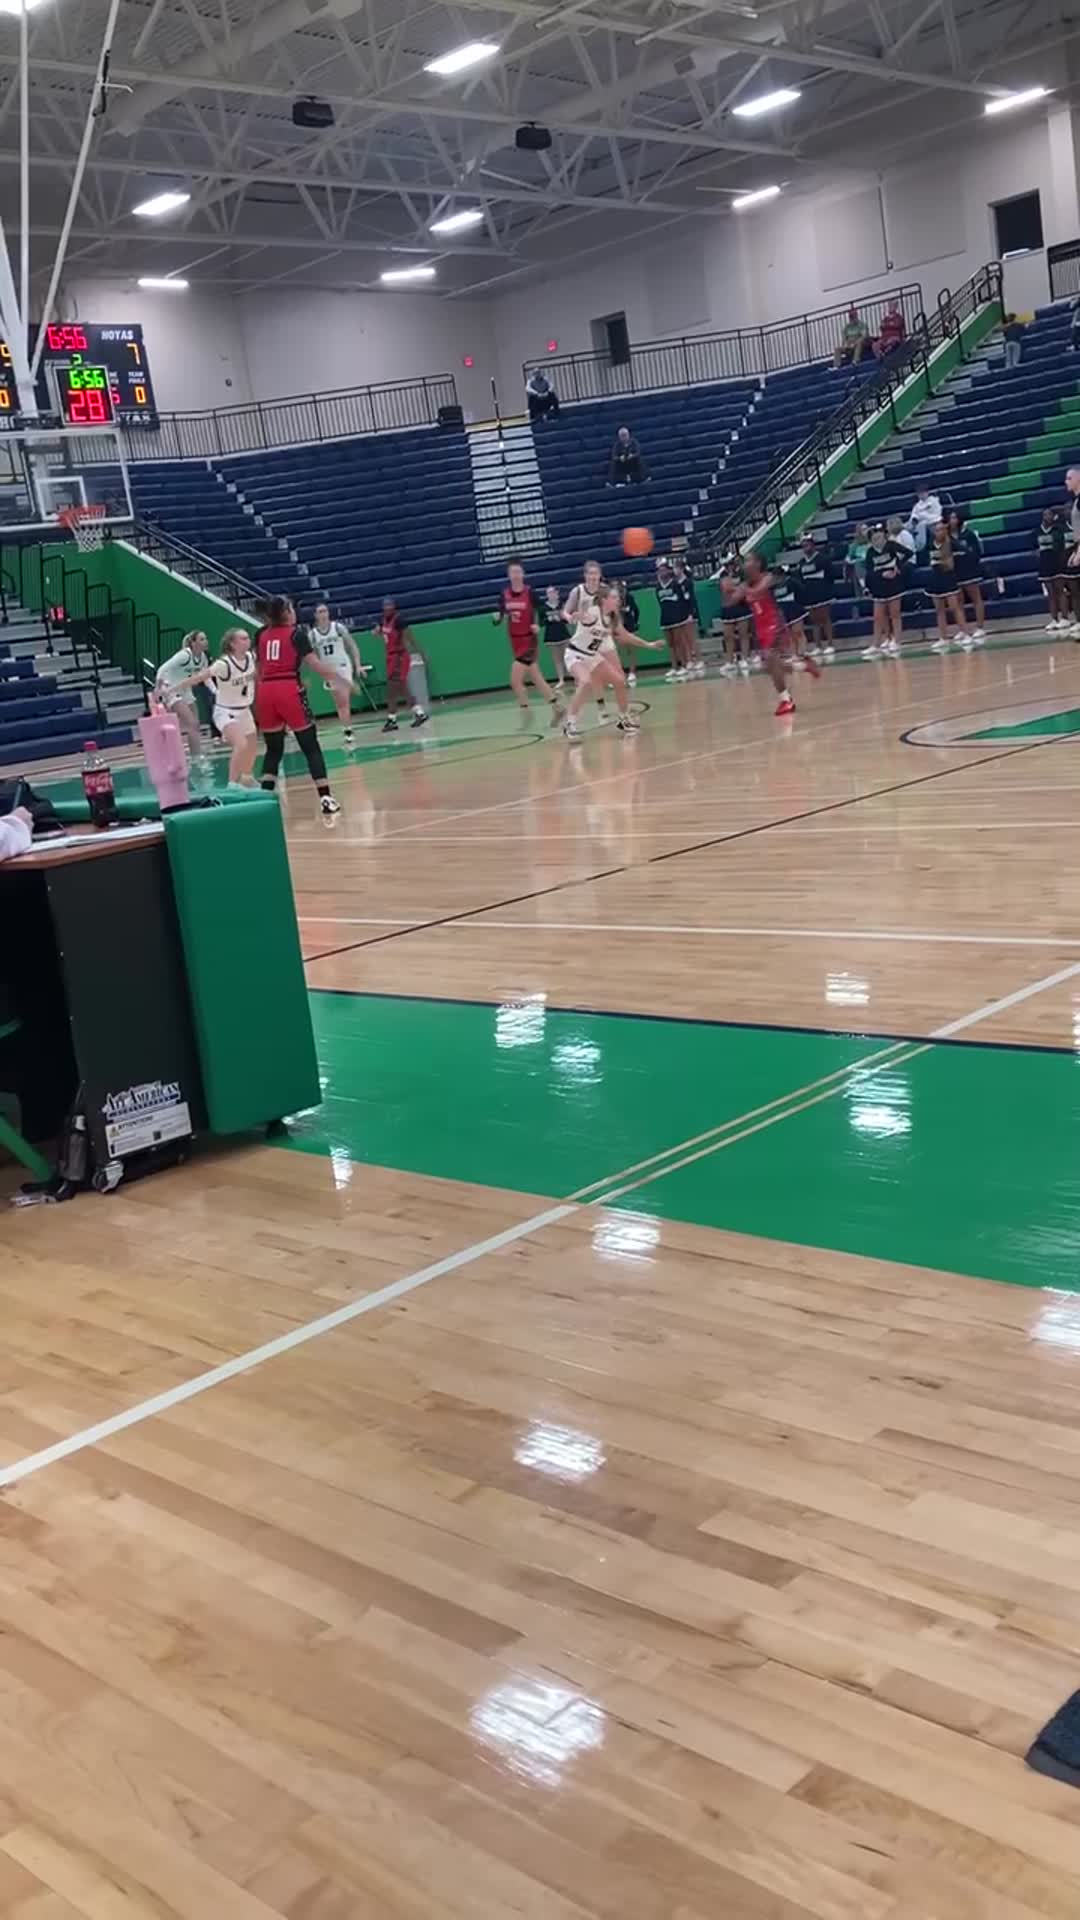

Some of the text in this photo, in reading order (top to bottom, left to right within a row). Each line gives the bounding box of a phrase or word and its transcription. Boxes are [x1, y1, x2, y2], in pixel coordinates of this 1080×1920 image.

[48, 327, 88, 349] 6:56
[101, 330, 134, 340] HOYAS
[126, 343, 140, 364] 7
[69, 370, 105, 388] 6:56
[68, 390, 105, 420] 28
[135, 386, 146, 404] 0
[266, 639, 281, 661] 10
